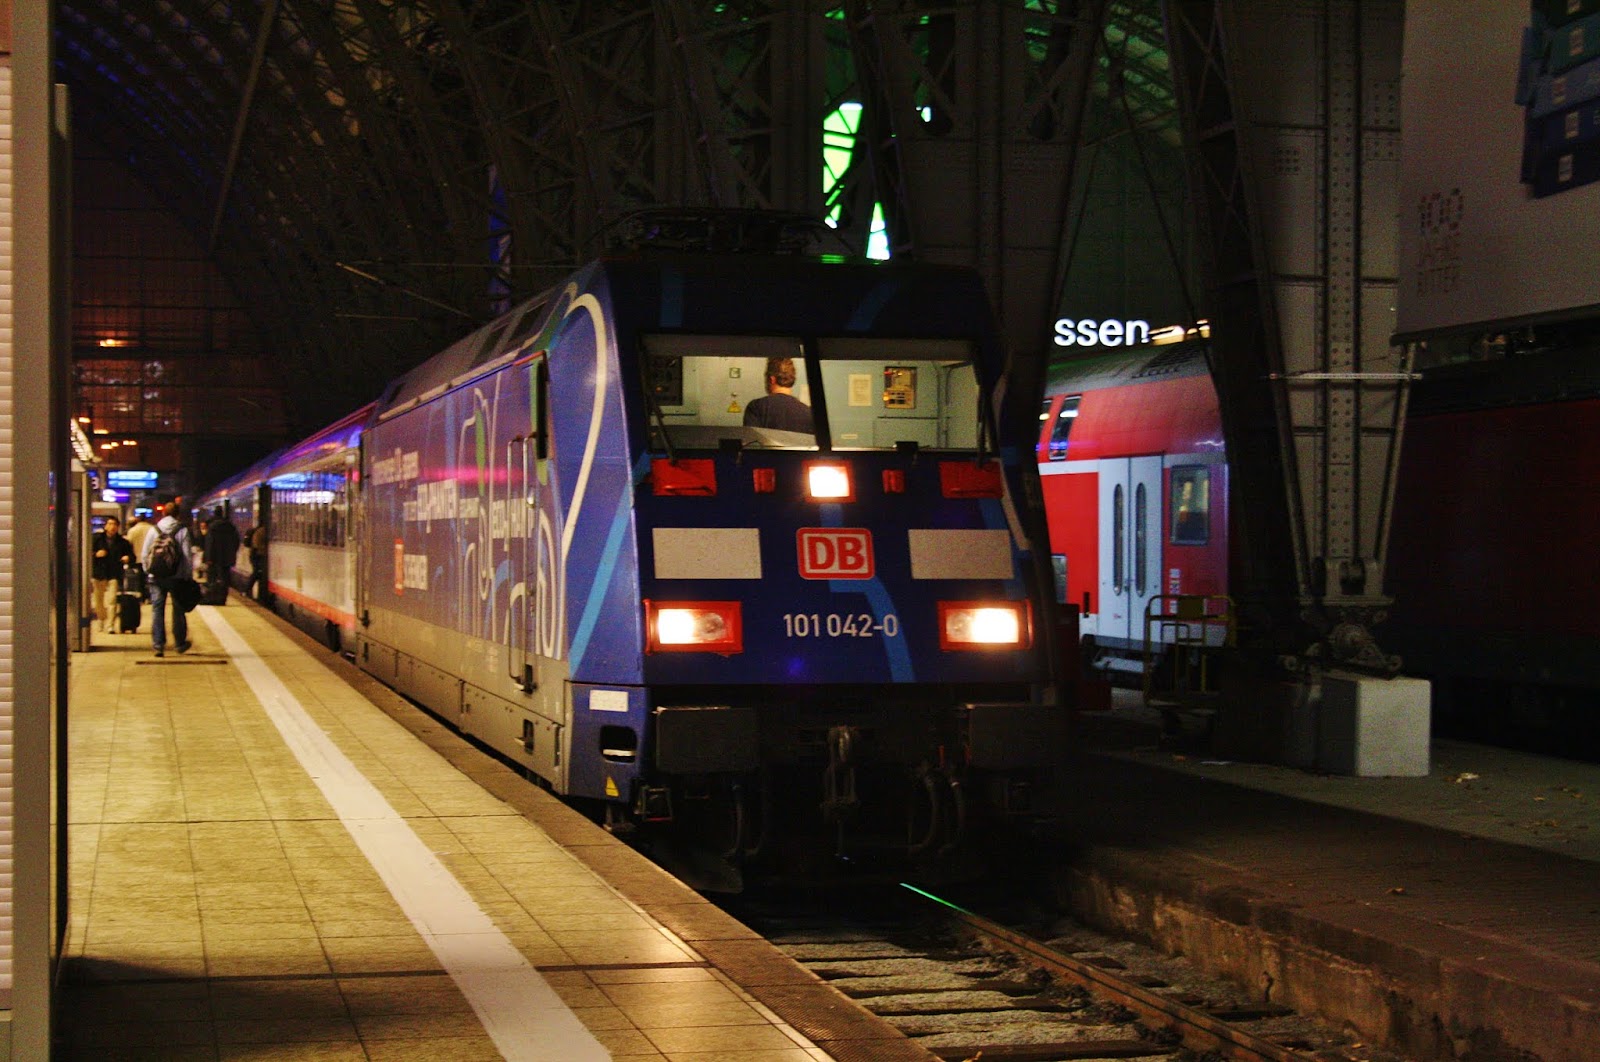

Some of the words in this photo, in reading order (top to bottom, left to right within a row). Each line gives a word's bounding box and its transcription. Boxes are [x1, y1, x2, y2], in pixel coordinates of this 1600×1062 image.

[807, 536, 864, 571] DB
[783, 613, 819, 637] 101
[827, 613, 898, 637] 042-0
